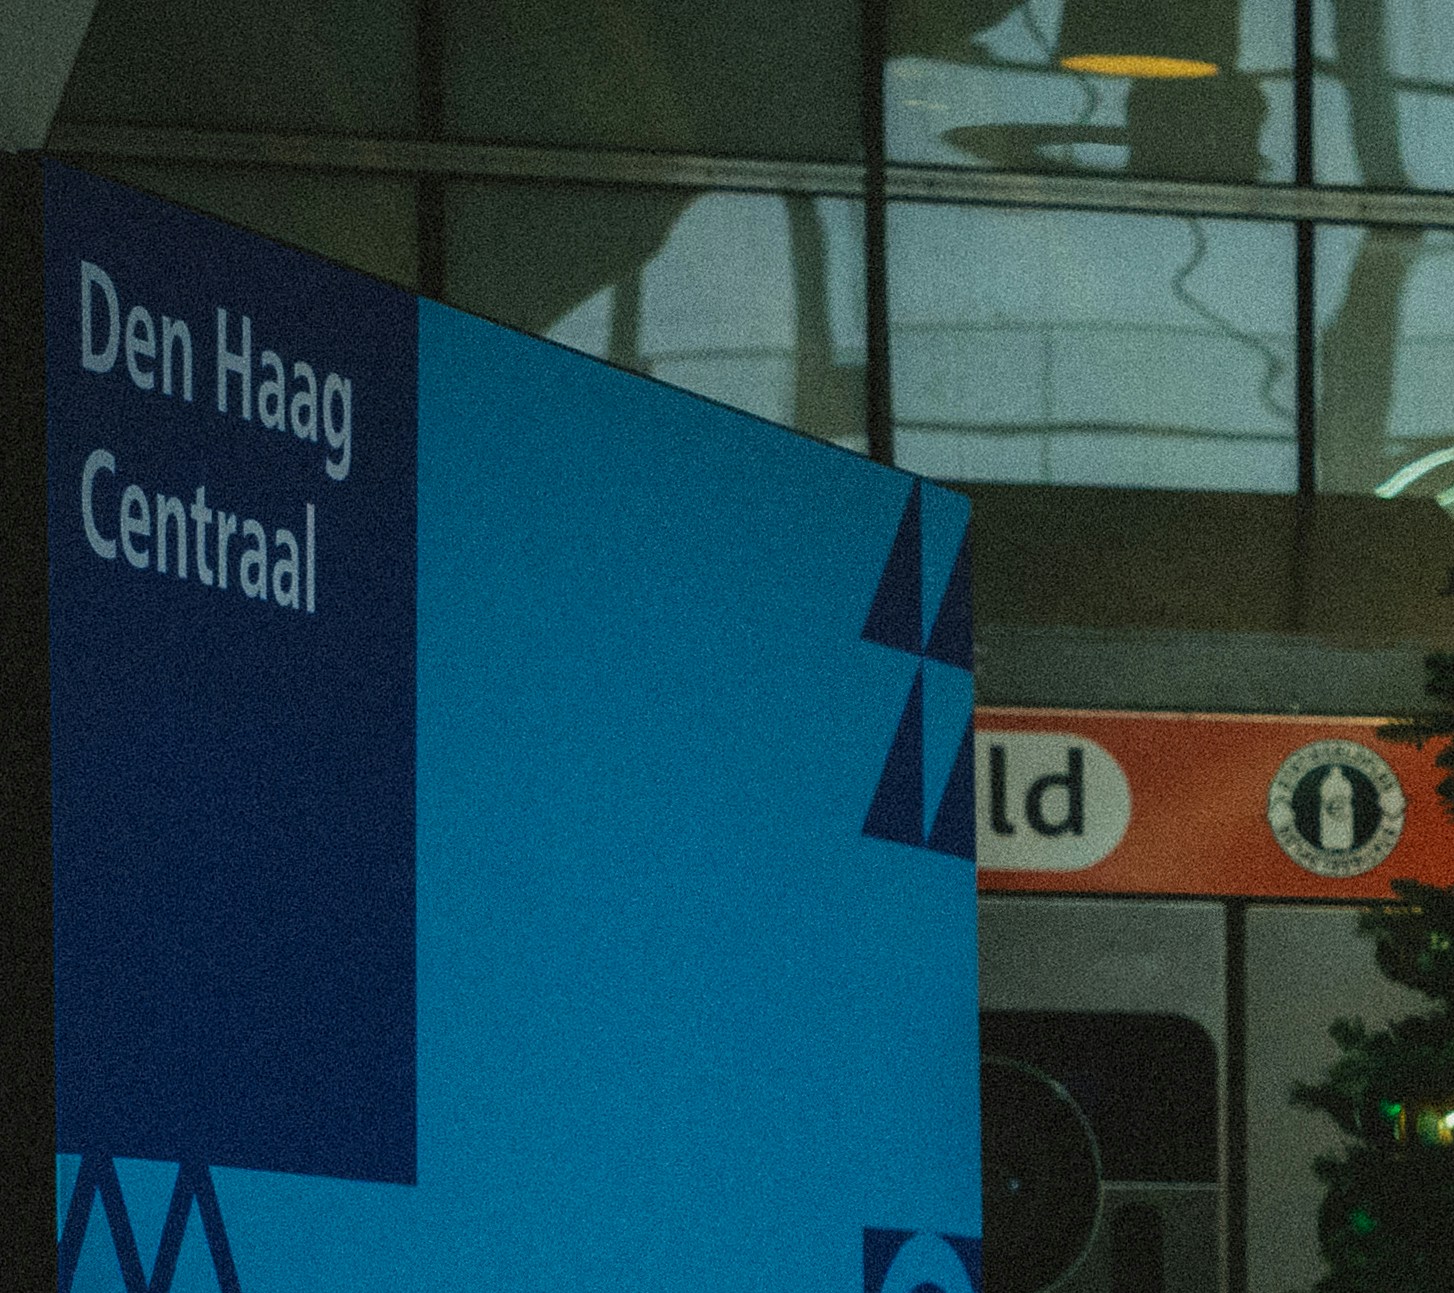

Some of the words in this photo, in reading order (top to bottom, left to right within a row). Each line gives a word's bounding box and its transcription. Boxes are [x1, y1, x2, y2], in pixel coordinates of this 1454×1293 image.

[80, 260, 194, 402] Den
[216, 307, 353, 481] Haag
[80, 448, 317, 614] Centraal
